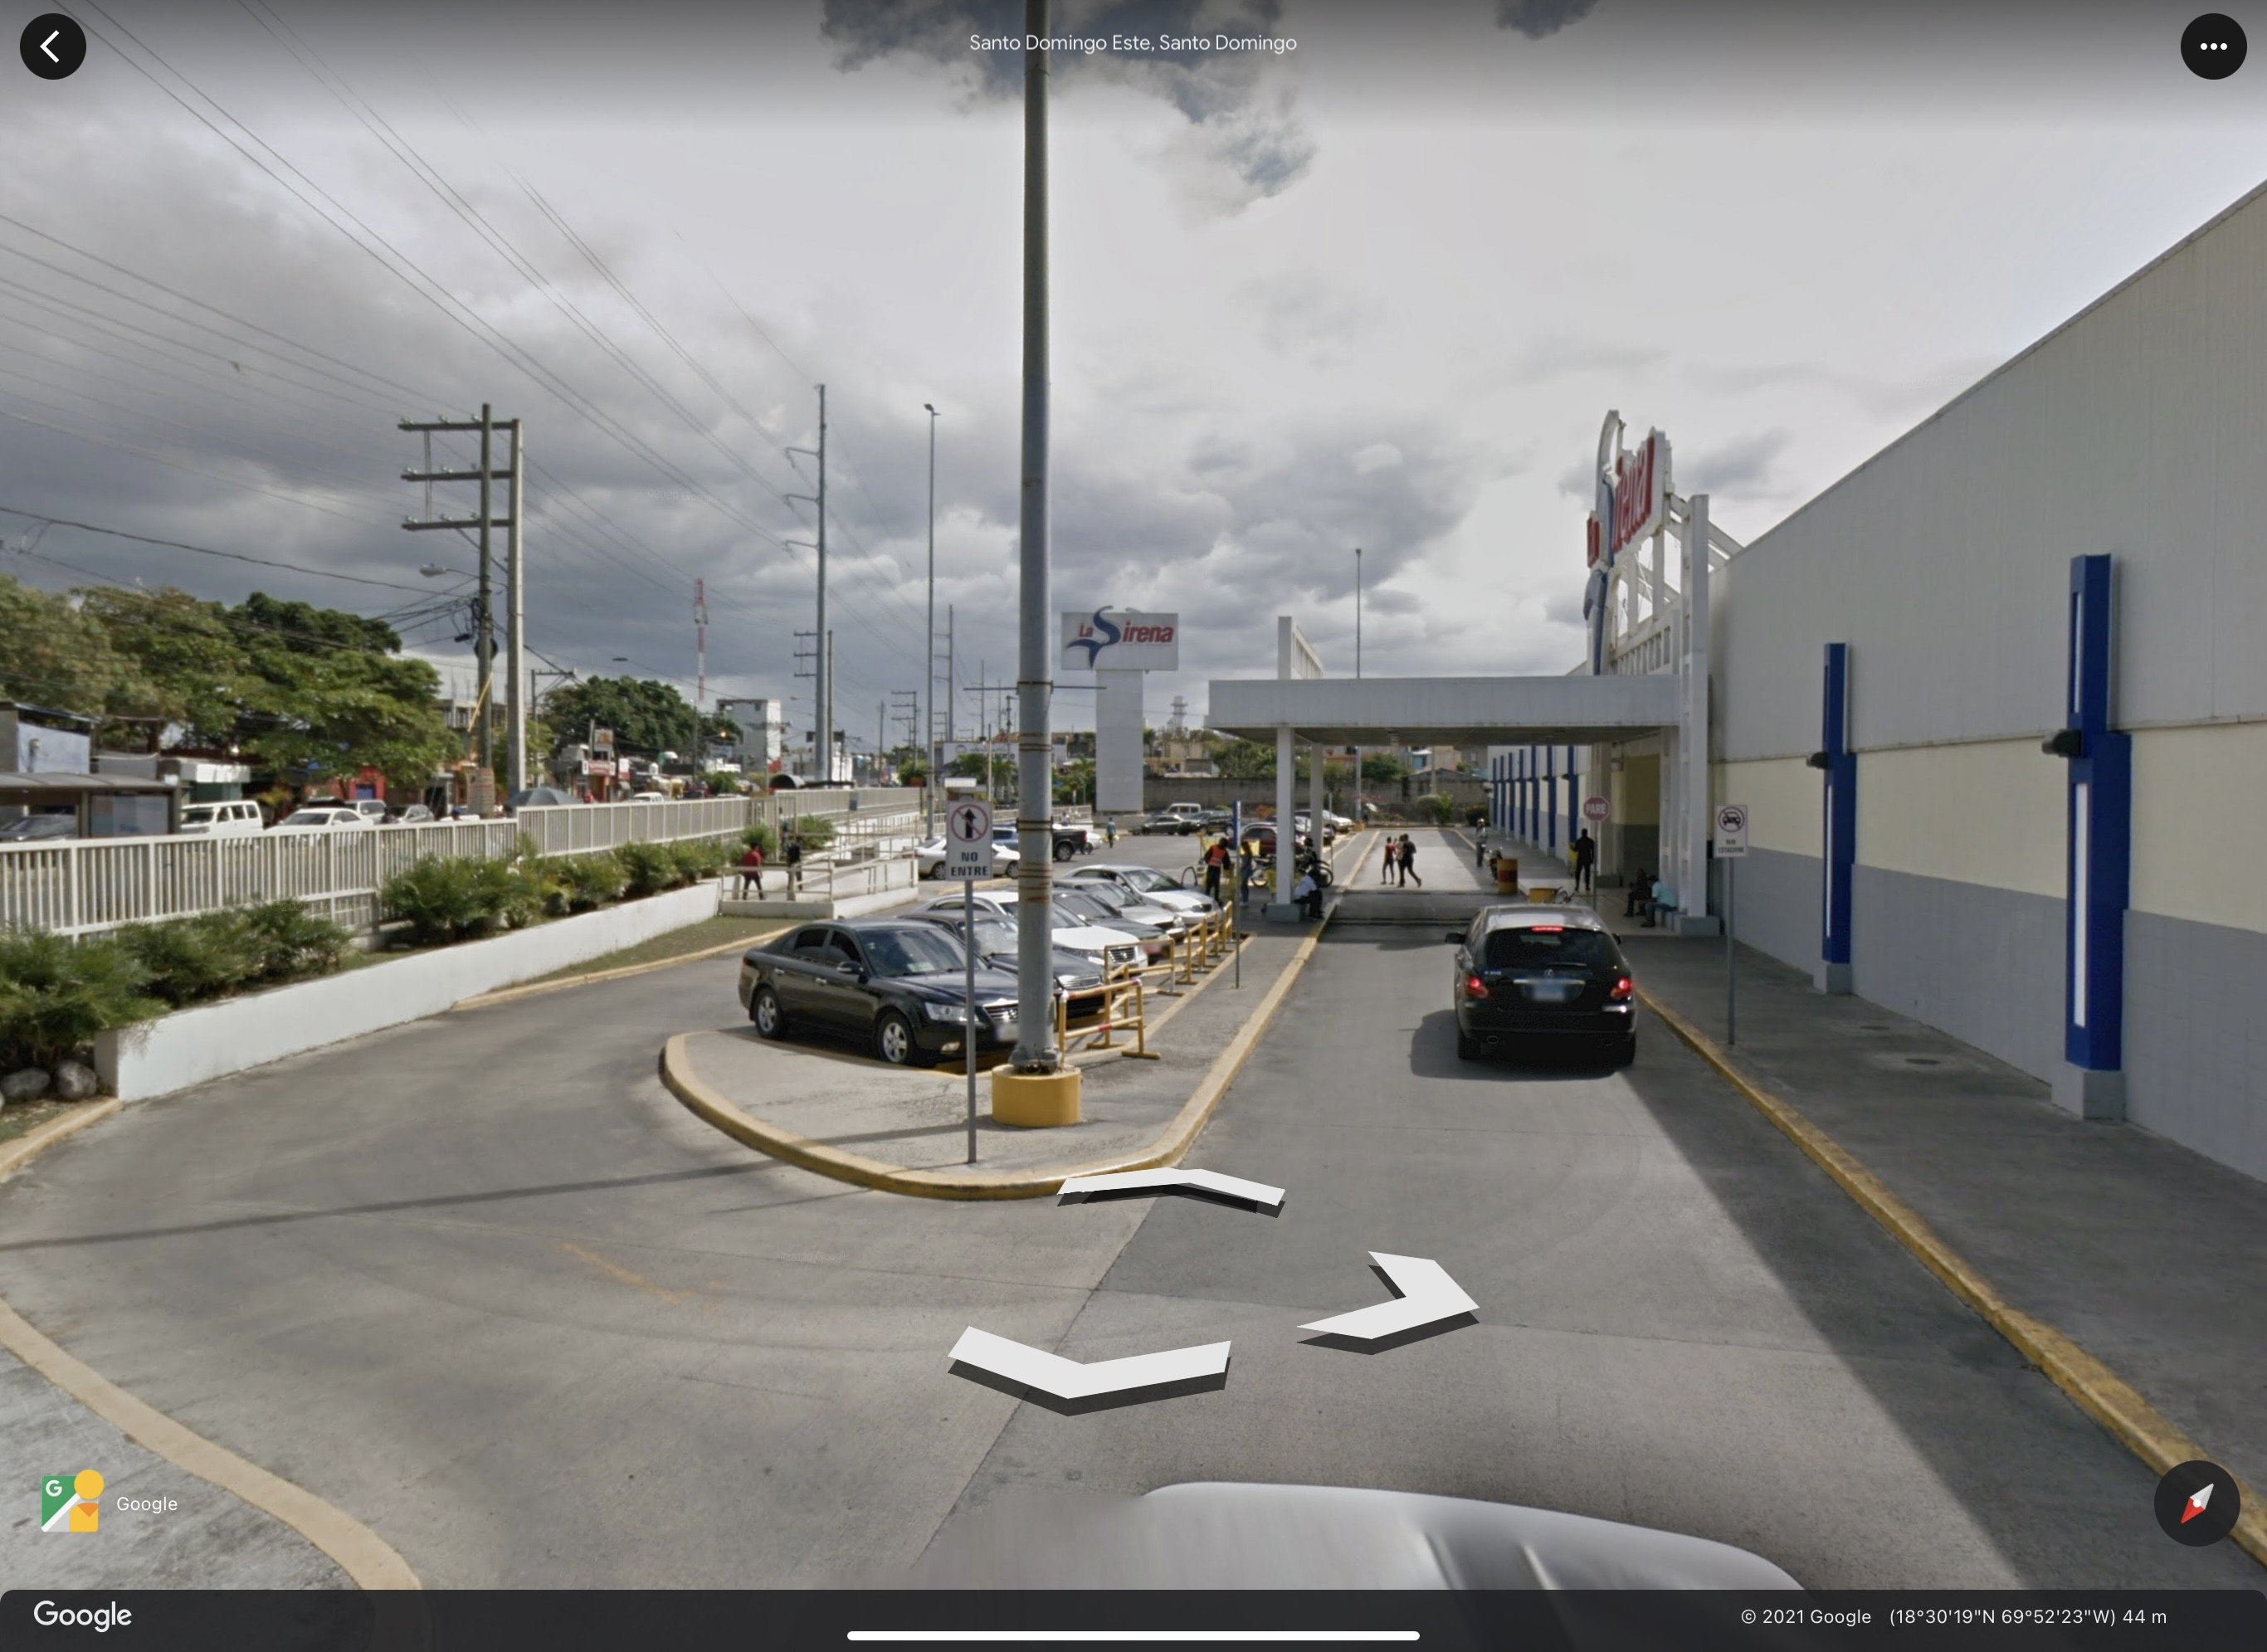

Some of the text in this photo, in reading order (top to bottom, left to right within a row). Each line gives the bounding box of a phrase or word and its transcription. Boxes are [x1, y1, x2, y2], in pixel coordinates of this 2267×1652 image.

[1067, 605, 1174, 670] La Sirena
[1586, 802, 1607, 815] PARE
[961, 851, 979, 862] NO
[951, 865, 988, 876] ENTRE
